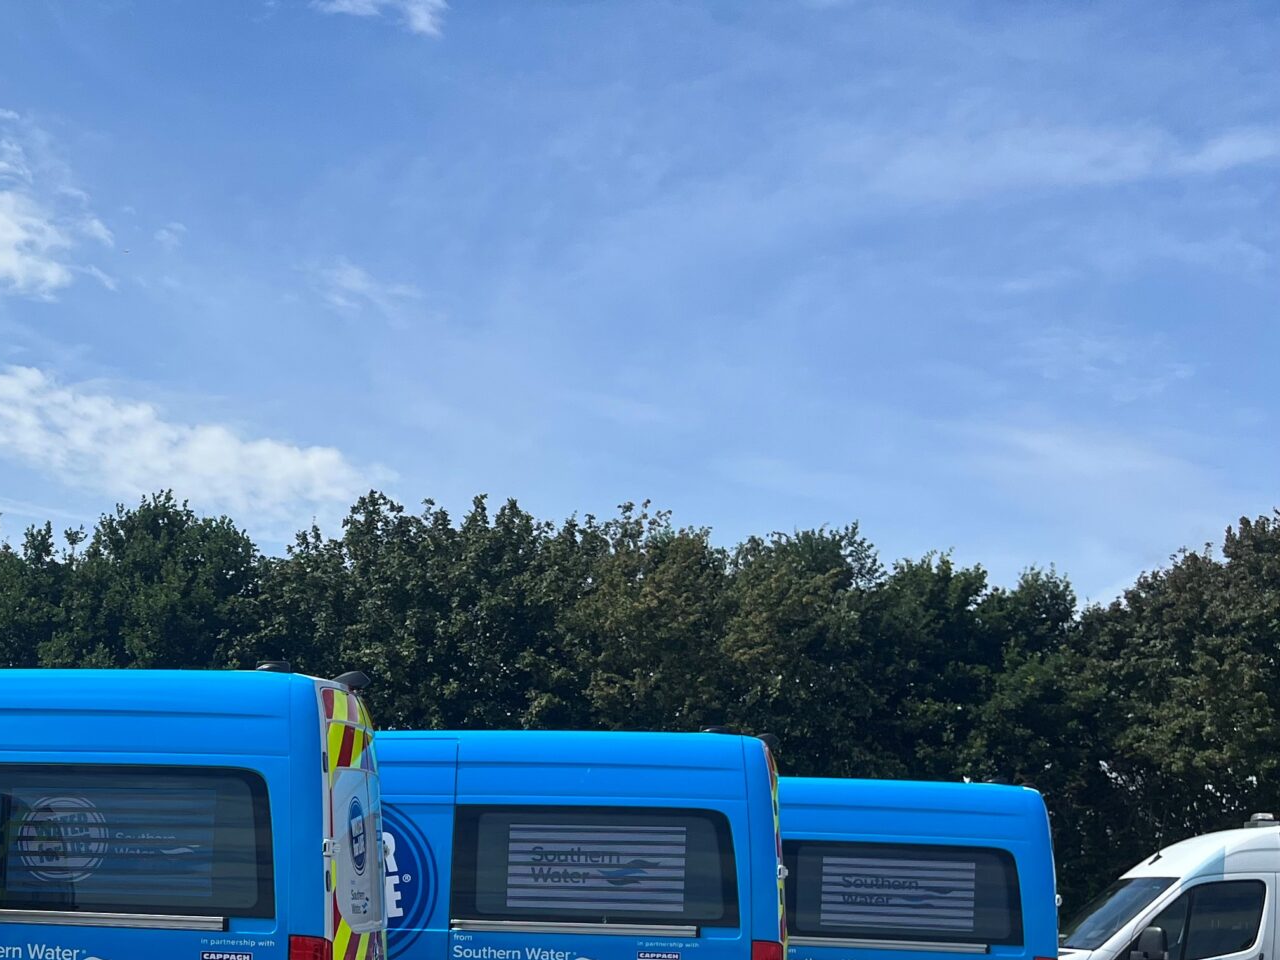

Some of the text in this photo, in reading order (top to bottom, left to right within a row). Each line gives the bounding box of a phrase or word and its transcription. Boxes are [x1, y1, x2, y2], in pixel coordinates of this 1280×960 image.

[531, 846, 620, 863] Southern
[531, 867, 590, 884] Water
[841, 875, 919, 891] Southern
[210, 938, 256, 947] partnership
[453, 933, 472, 941] from
[27, 943, 79, 960] Water
[203, 953, 250, 960] CAPPAGH
[453, 945, 570, 960] Southern Water
